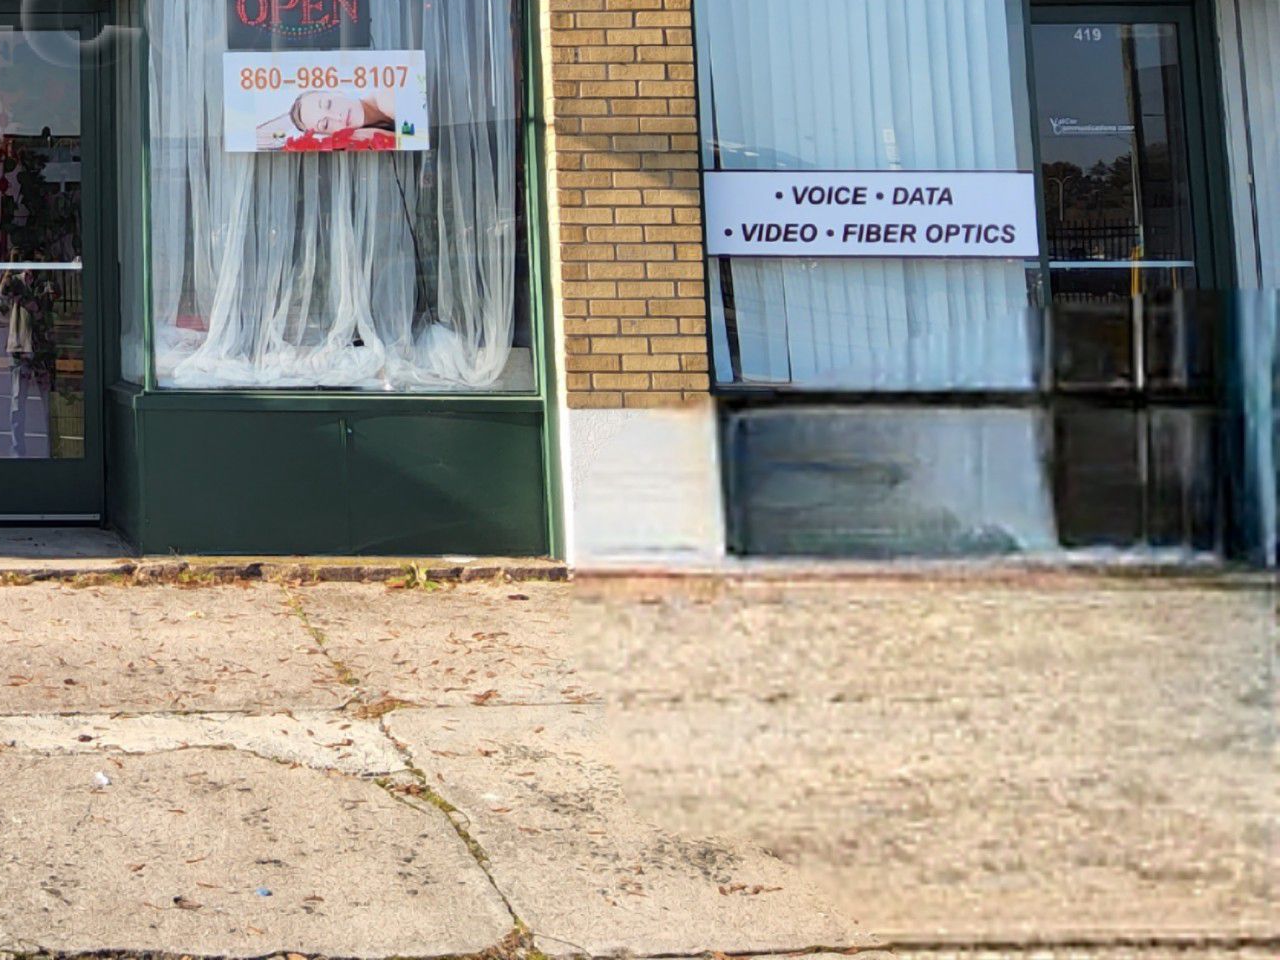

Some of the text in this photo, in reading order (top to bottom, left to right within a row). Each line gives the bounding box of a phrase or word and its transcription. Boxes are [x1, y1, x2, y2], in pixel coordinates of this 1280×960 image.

[1073, 27, 1102, 41] 419
[240, 66, 409, 90] 860-986-8107
[791, 186, 954, 205] VOICE DATA
[741, 224, 1016, 243] VIDEO FIBER OPTICS
